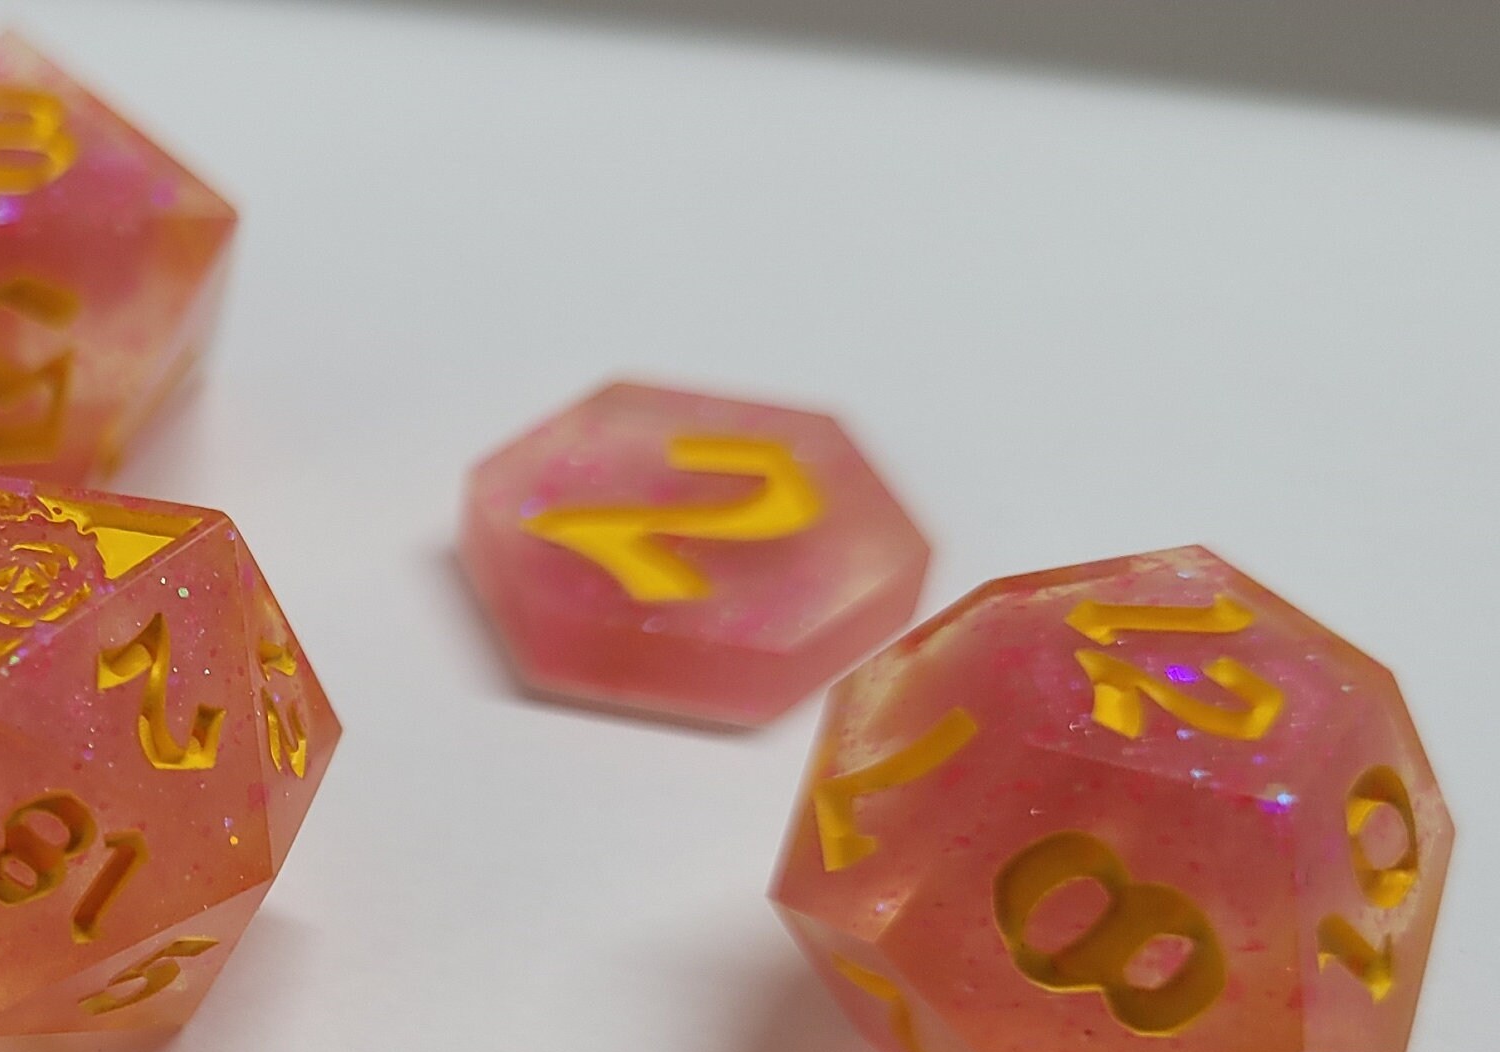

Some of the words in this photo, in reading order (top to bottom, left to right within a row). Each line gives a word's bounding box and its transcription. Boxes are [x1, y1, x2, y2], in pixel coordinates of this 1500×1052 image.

[521, 436, 820, 605] 2
[98, 613, 226, 769] 2
[1064, 593, 1285, 741] 12
[993, 829, 1228, 1038] 8
